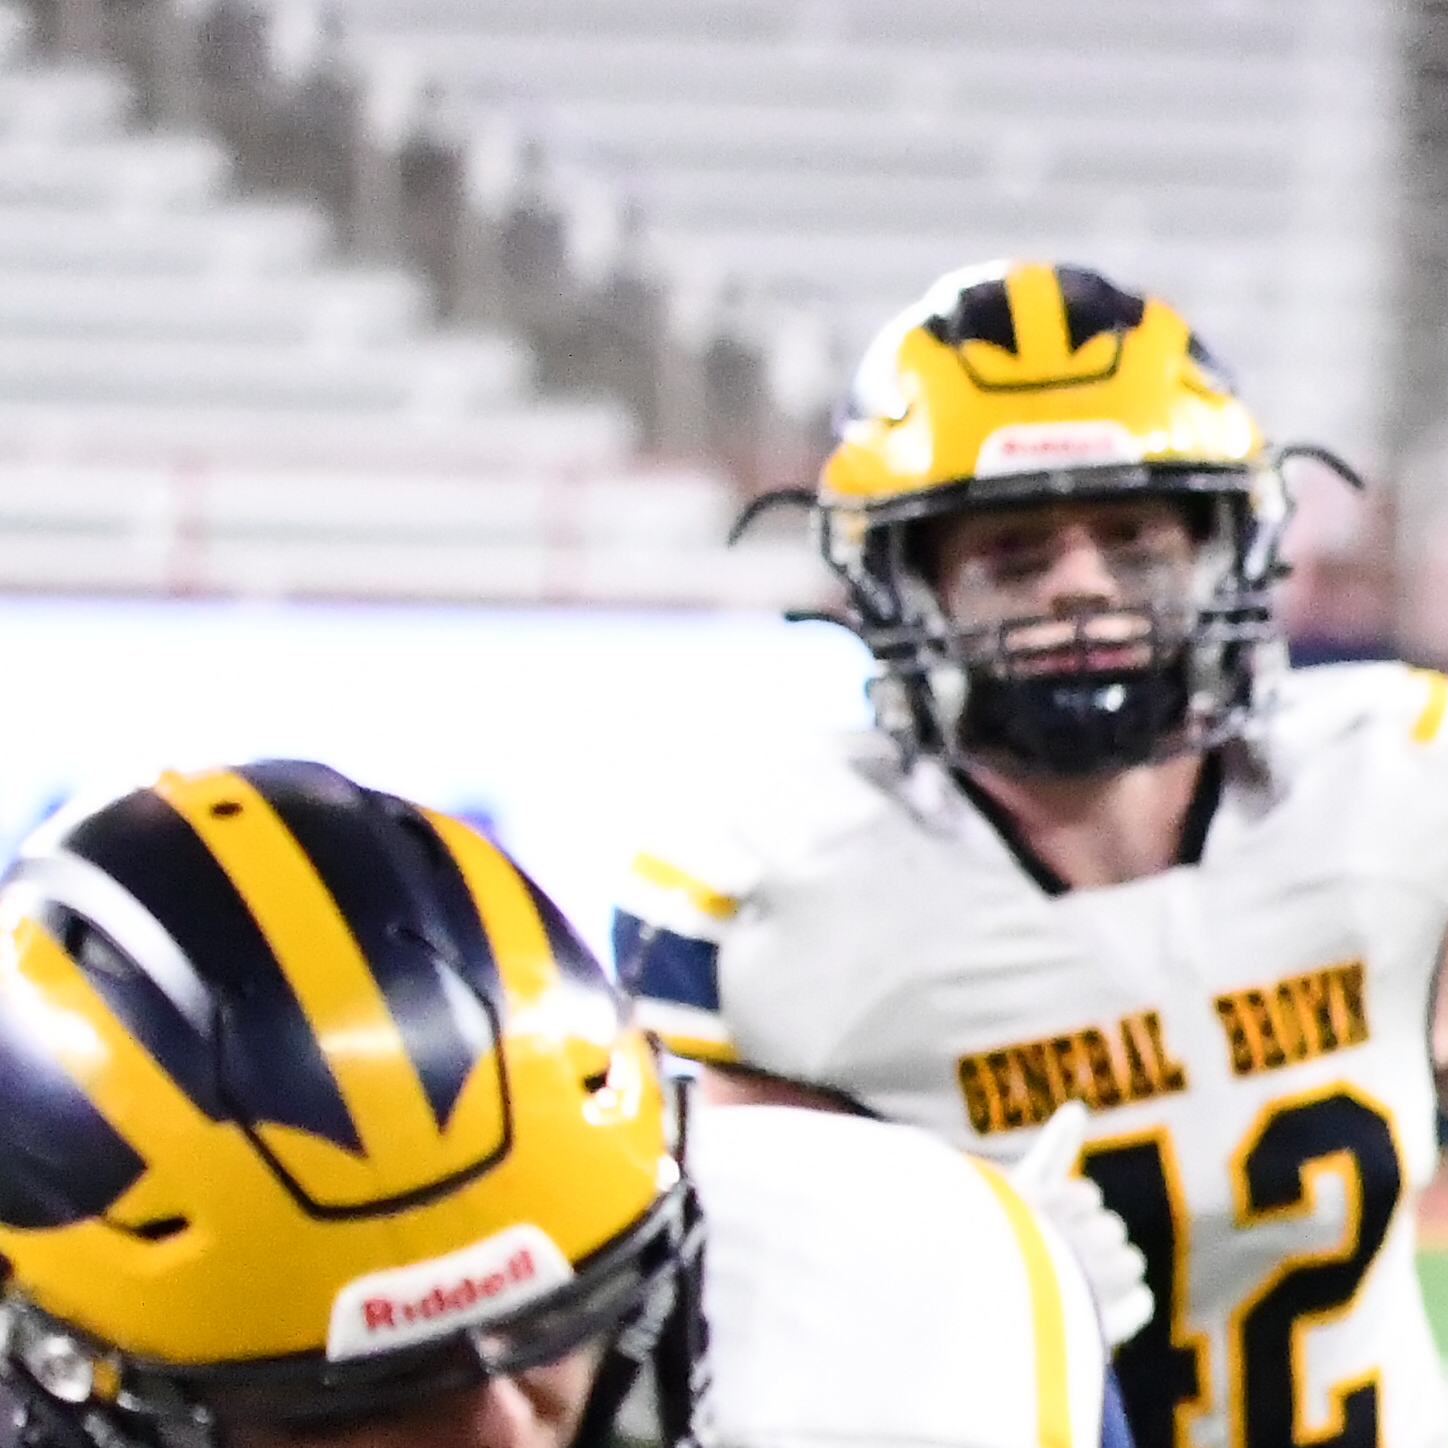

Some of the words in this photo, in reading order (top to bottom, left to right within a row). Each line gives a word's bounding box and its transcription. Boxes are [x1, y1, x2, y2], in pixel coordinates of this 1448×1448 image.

[956, 1010, 1187, 1136] GENERAL
[1213, 959, 1369, 1078] BROWN
[363, 1248, 535, 1332] Riddell
